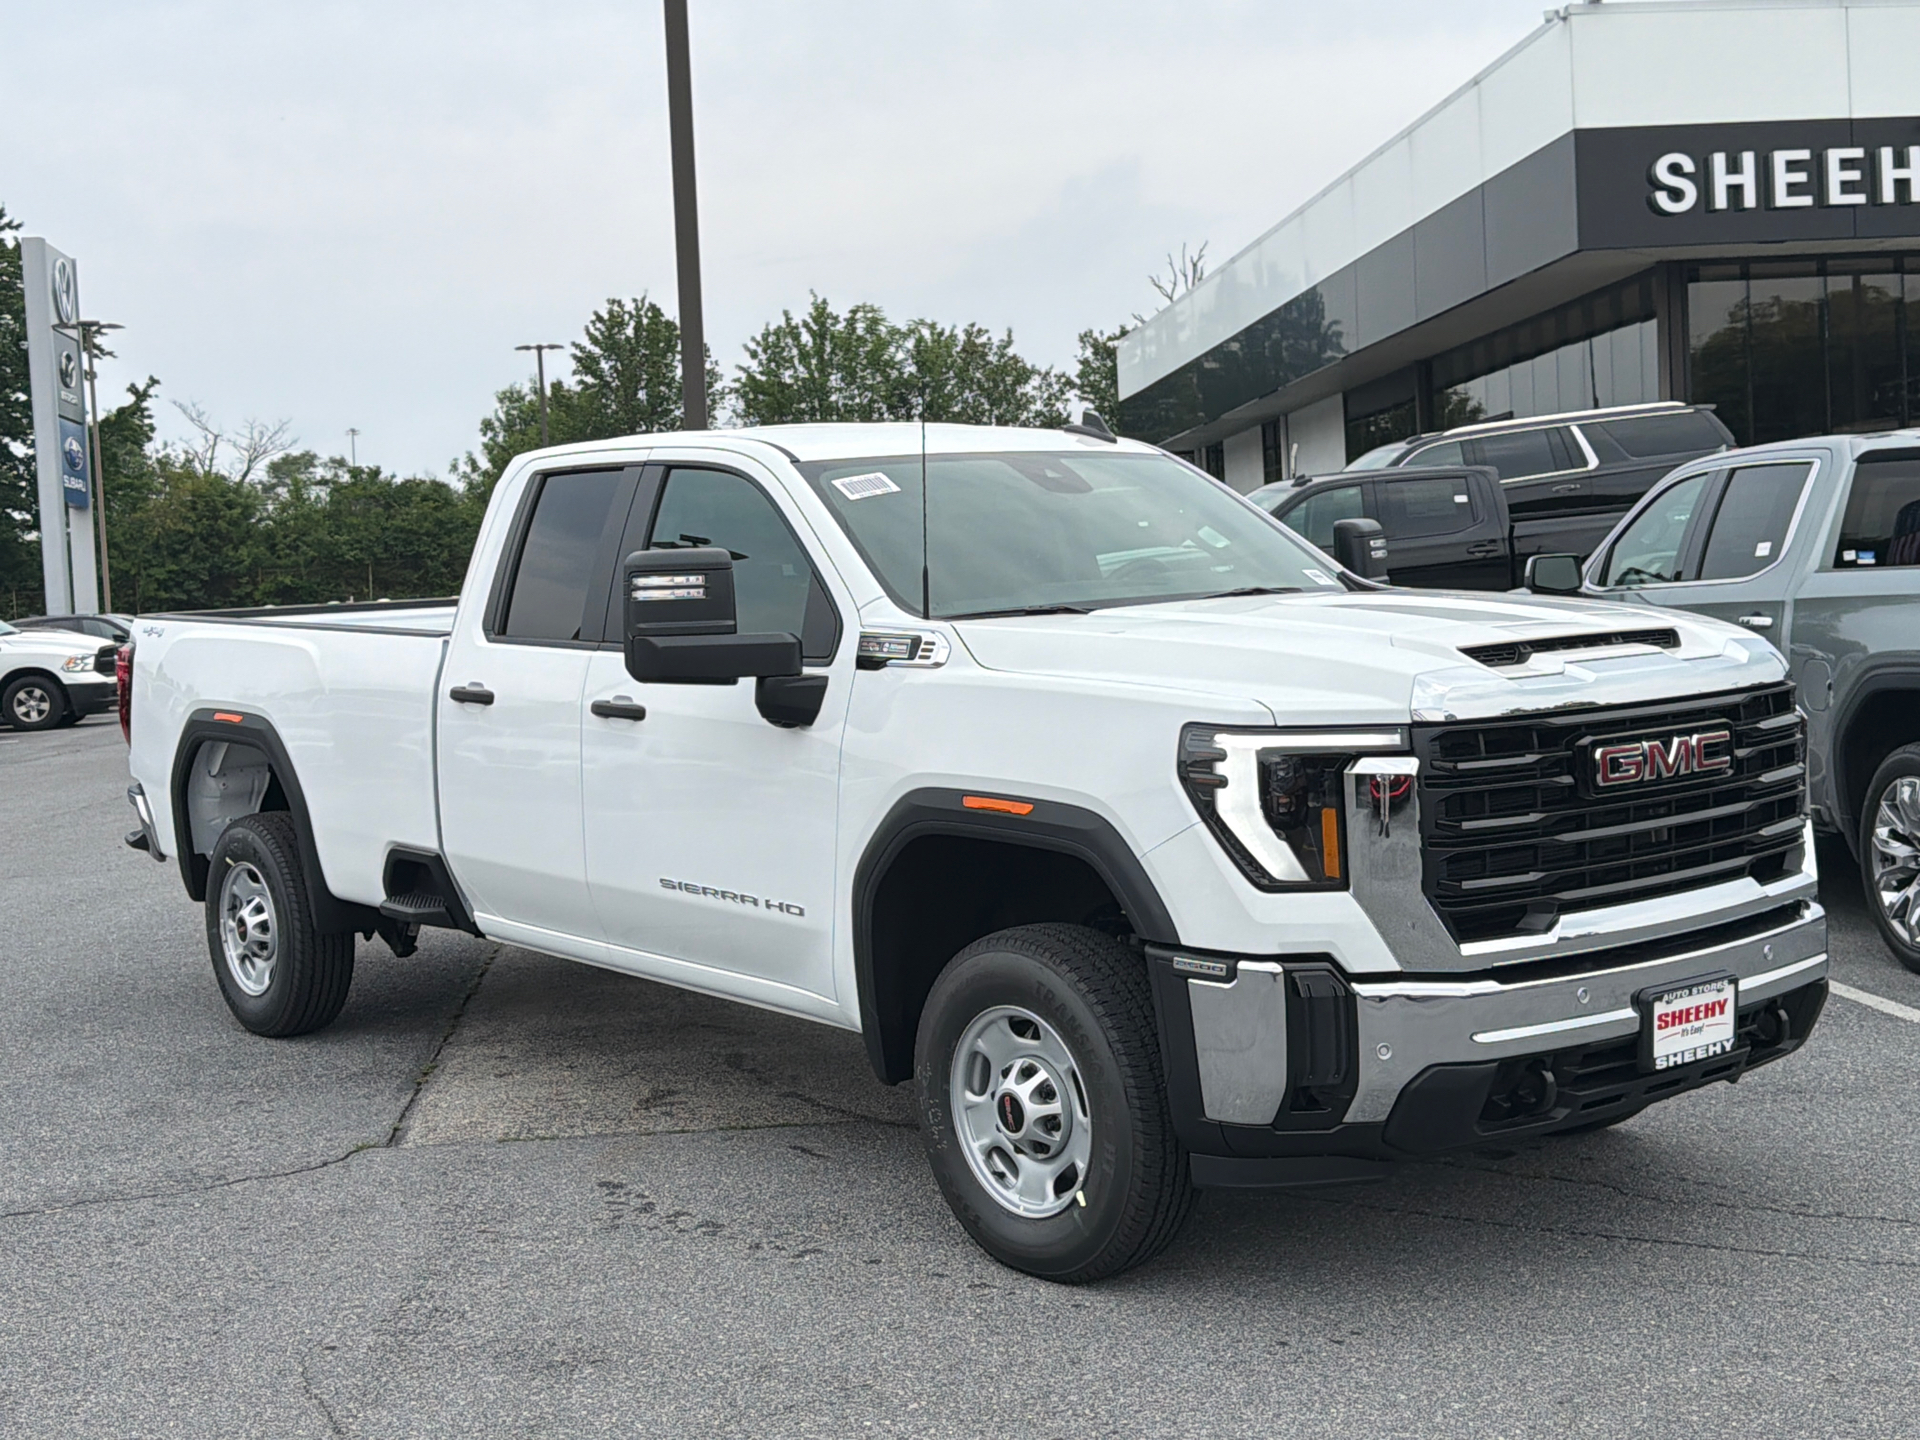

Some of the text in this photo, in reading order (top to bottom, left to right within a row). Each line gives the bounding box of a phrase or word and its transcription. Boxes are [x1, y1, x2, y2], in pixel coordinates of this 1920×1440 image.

[1651, 146, 1920, 213] SHEEH
[63, 474, 87, 492] SUBARU
[1595, 730, 1730, 786] GMC
[659, 878, 805, 917] SIERRA HD
[1662, 989, 1689, 1001] AUTO
[1657, 998, 1729, 1031] SHEEHY
[1655, 1038, 1734, 1070] SHEEHY
